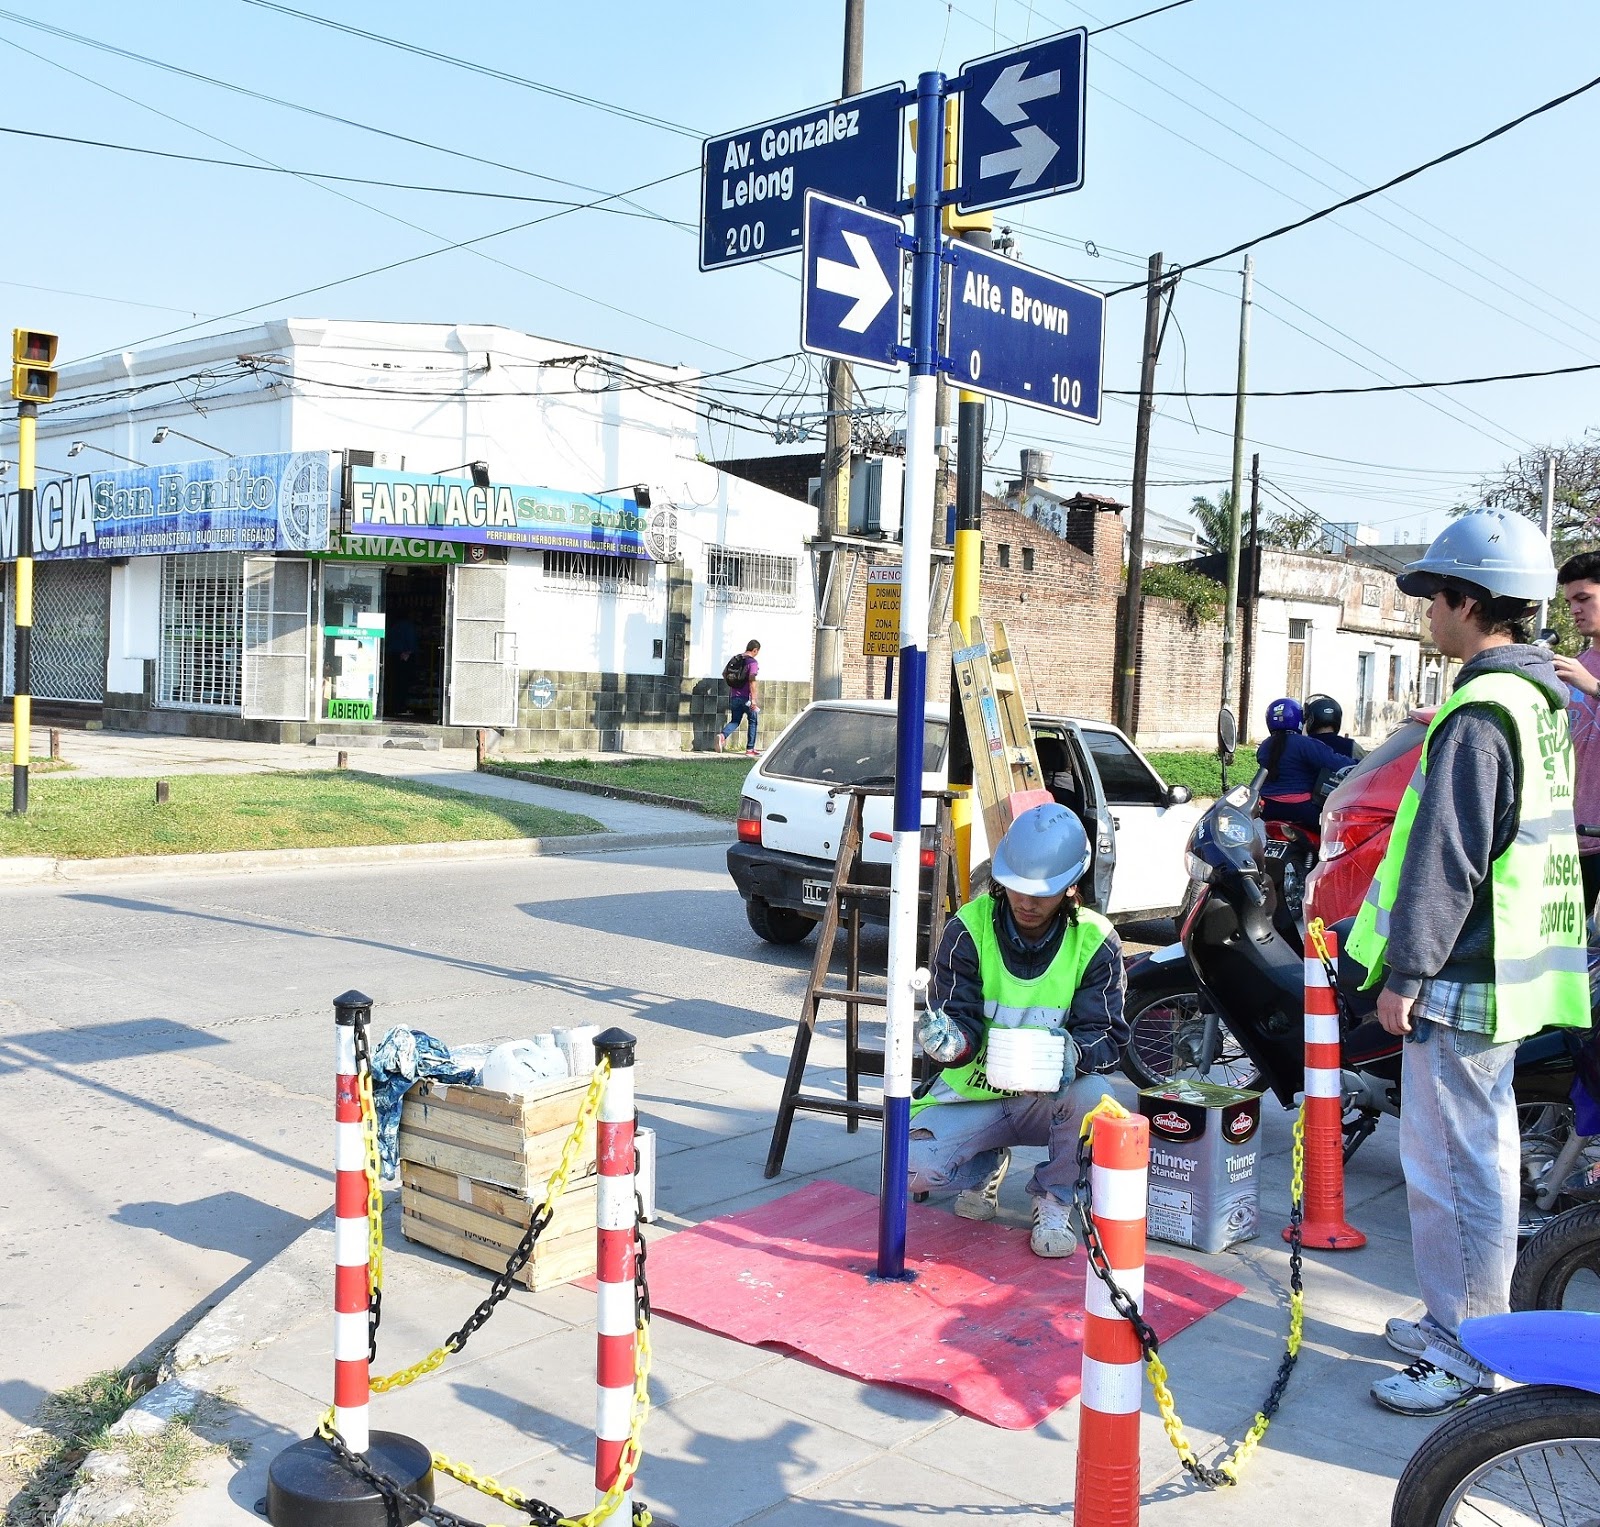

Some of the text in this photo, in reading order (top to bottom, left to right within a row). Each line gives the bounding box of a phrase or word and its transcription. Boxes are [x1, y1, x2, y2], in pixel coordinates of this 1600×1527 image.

[723, 109, 860, 173] Av. Gonzalez
[721, 166, 794, 210] Lelong
[726, 220, 766, 256] 200
[963, 271, 1069, 336] Alte. Brown
[970, 350, 982, 381] 0
[1052, 373, 1082, 408] 100
[92, 481, 153, 520] San
[158, 469, 275, 516] Benito
[352, 482, 517, 527] FARMACIA
[517, 497, 567, 524] San
[571, 503, 647, 532] Benito
[98, 527, 275, 549] PERFUMERIA HERBORISTERIA BIJOUTERIE REGALOS
[311, 535, 457, 558] ARMACIA
[486, 530, 645, 555] PERFUMERIA HERBORISTERIA BIJOUTERIE REGALOS
[869, 570, 901, 580] ATENC
[869, 600, 878, 610] LA
[875, 618, 892, 629] ZONA
[866, 642, 875, 653] DE
[962, 669, 972, 687] 5
[331, 702, 370, 720] ABIERTO
[804, 885, 822, 900] ILC
[1155, 1116, 1188, 1130] Sinteplast
[1226, 1152, 1256, 1173] Thinner
[1151, 1165, 1190, 1182] Standard
[1230, 1167, 1253, 1183] Standard
